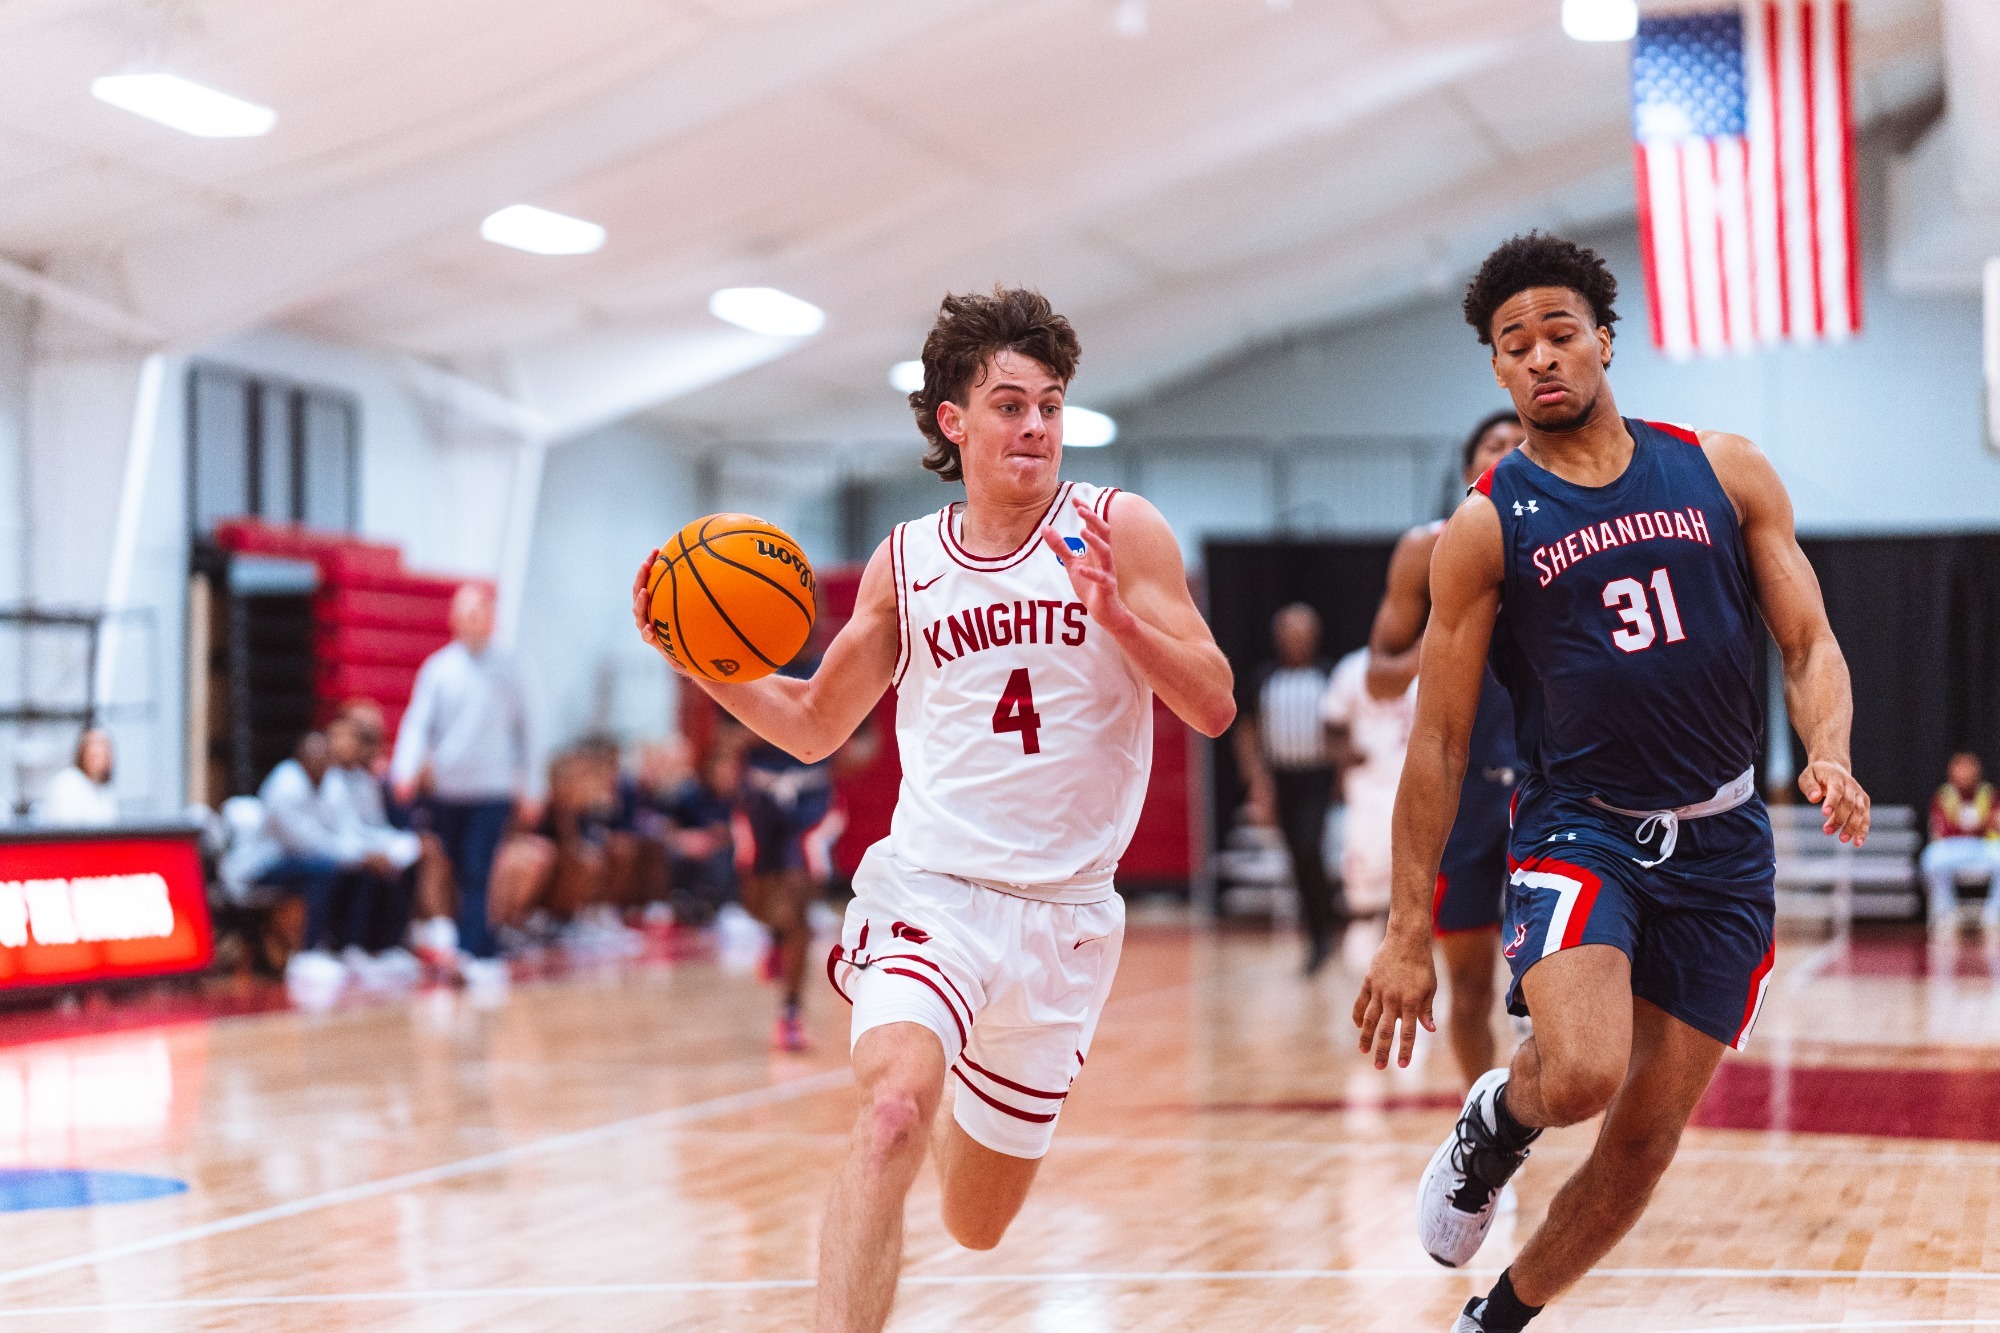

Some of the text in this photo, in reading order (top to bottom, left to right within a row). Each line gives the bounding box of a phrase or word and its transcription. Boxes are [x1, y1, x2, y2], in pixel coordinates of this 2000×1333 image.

[1532, 507, 1713, 589] SHENANDOAH
[922, 599, 1089, 669] KNIGHTS
[1602, 566, 1688, 654] 31
[992, 667, 1042, 756] 4
